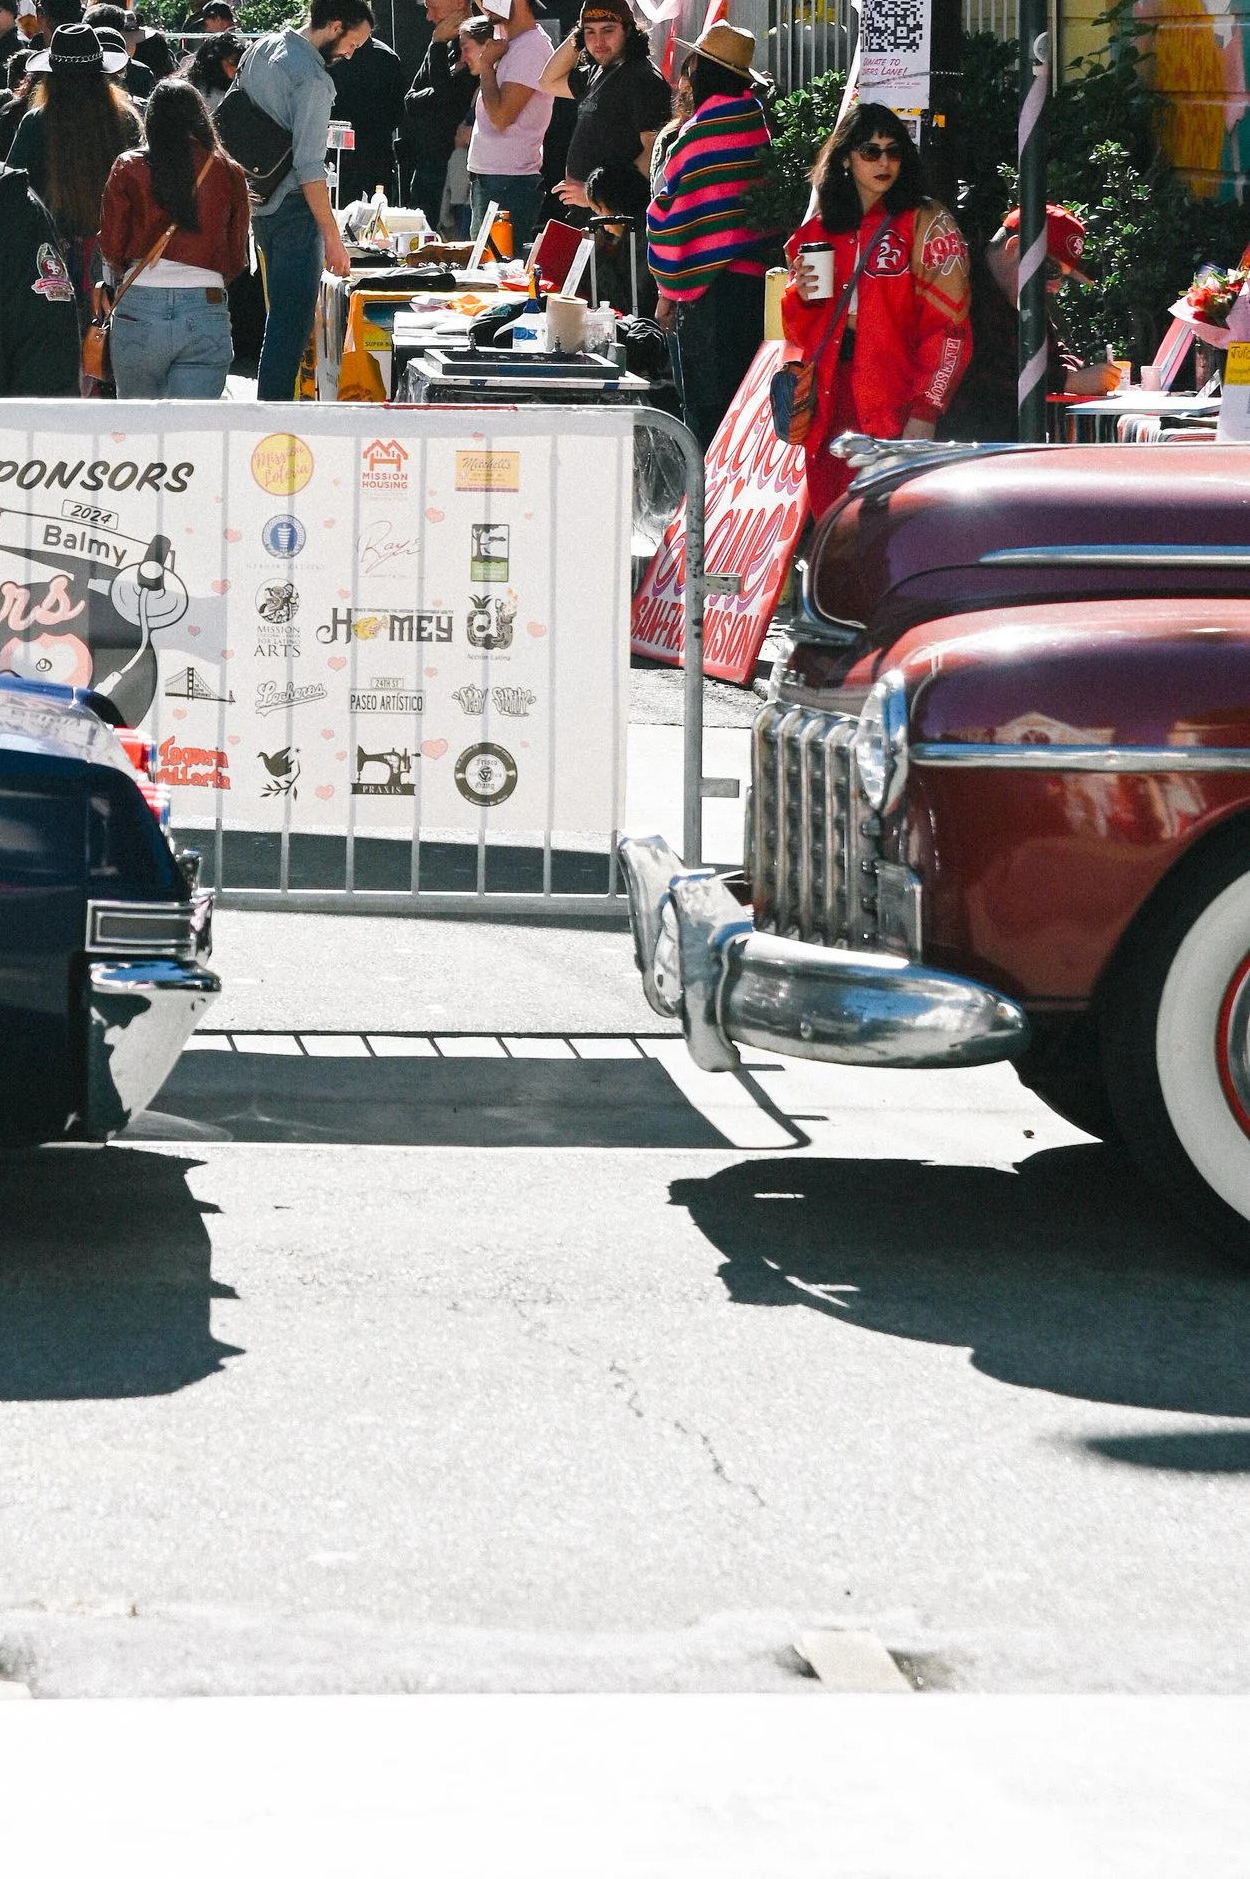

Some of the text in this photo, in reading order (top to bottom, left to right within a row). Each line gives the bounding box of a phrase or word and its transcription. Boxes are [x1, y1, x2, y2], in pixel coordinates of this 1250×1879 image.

[890, 58, 901, 66] TO
[881, 66, 908, 77] LANE!
[362, 472, 408, 481] MISSION
[361, 480, 408, 489] HOUSING
[70, 504, 112, 525] 2024
[42, 524, 128, 566] Balmy
[253, 644, 301, 658] ARTS
[375, 678, 391, 688] 24TH
[350, 693, 377, 711] PASEO
[362, 784, 403, 794] PRAXIS
